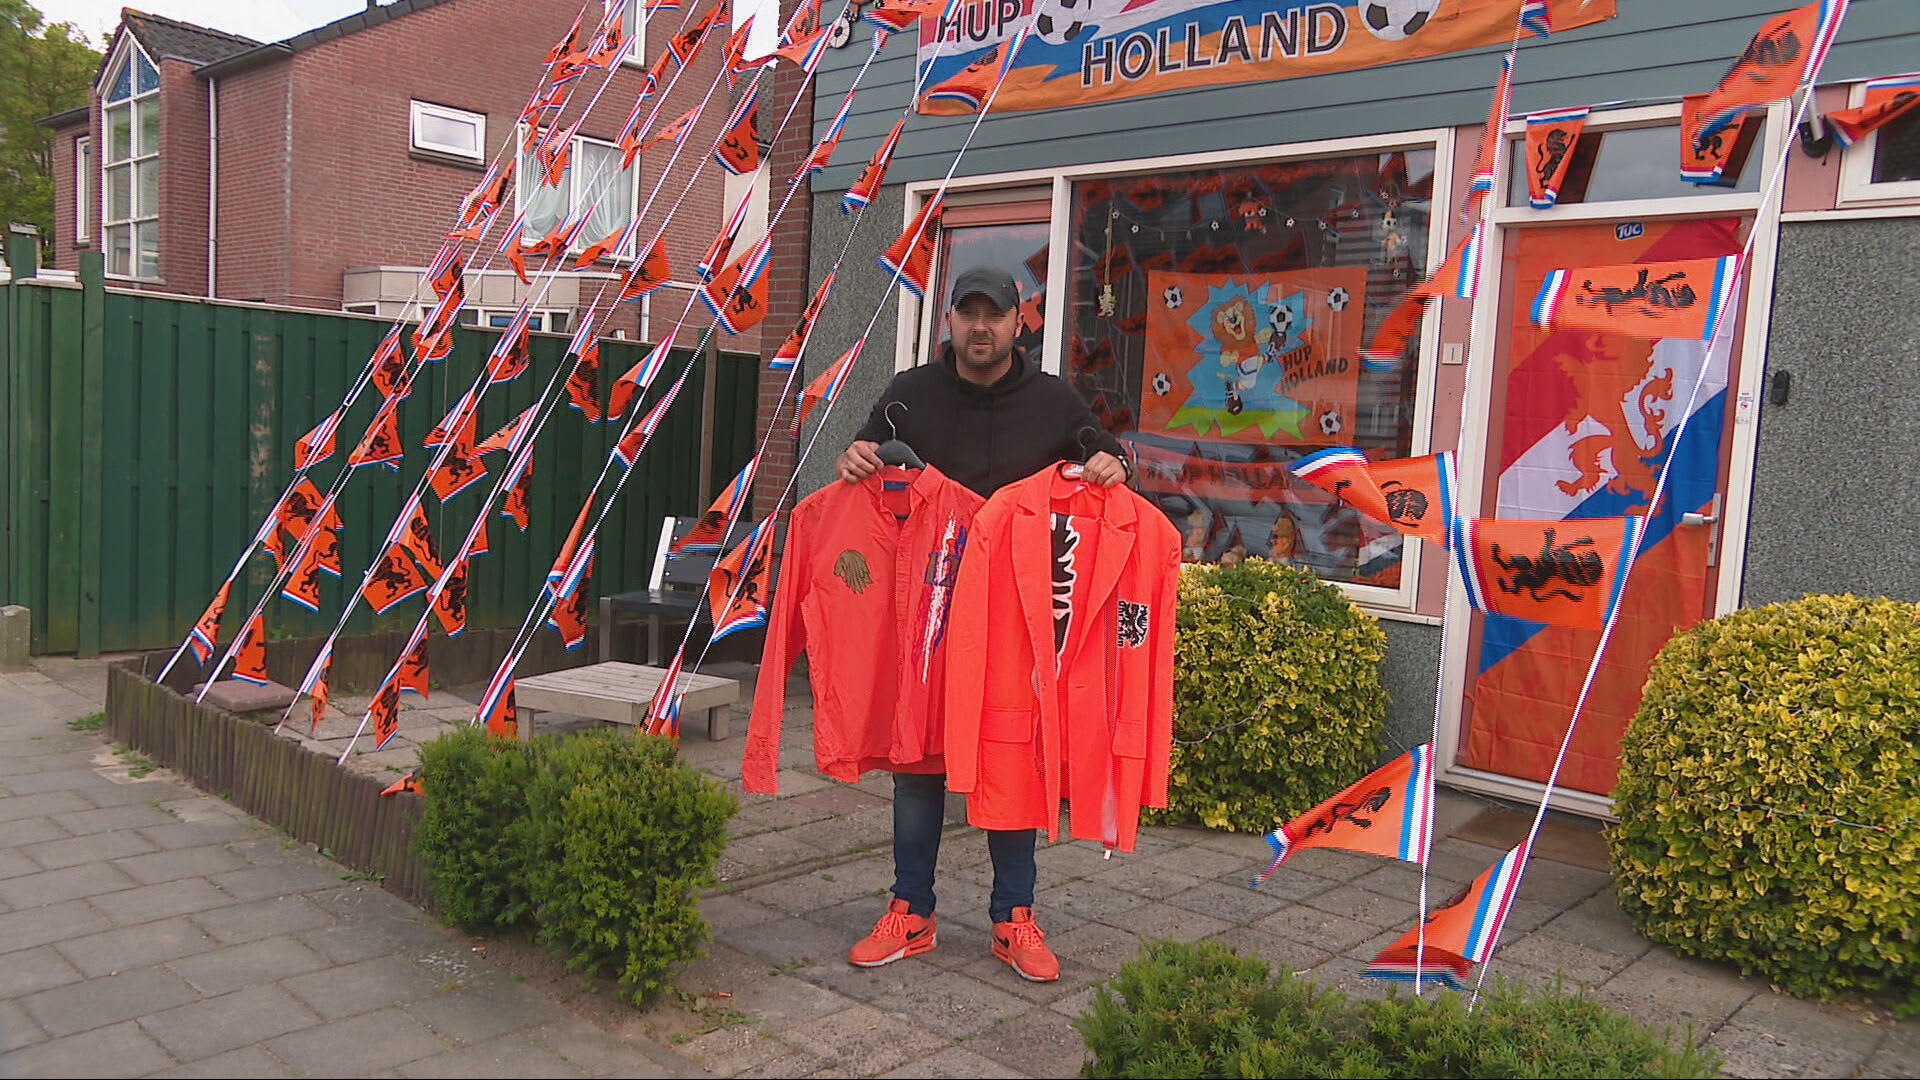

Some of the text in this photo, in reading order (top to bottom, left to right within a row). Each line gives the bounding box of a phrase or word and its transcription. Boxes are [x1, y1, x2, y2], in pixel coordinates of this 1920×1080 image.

[936, 0, 1021, 43] HUP
[1081, 3, 1348, 87] HOLLAND
[1617, 223, 1641, 238] TUC
[1281, 357, 1348, 393] HOLLAND
[1283, 345, 1312, 371] HUP
